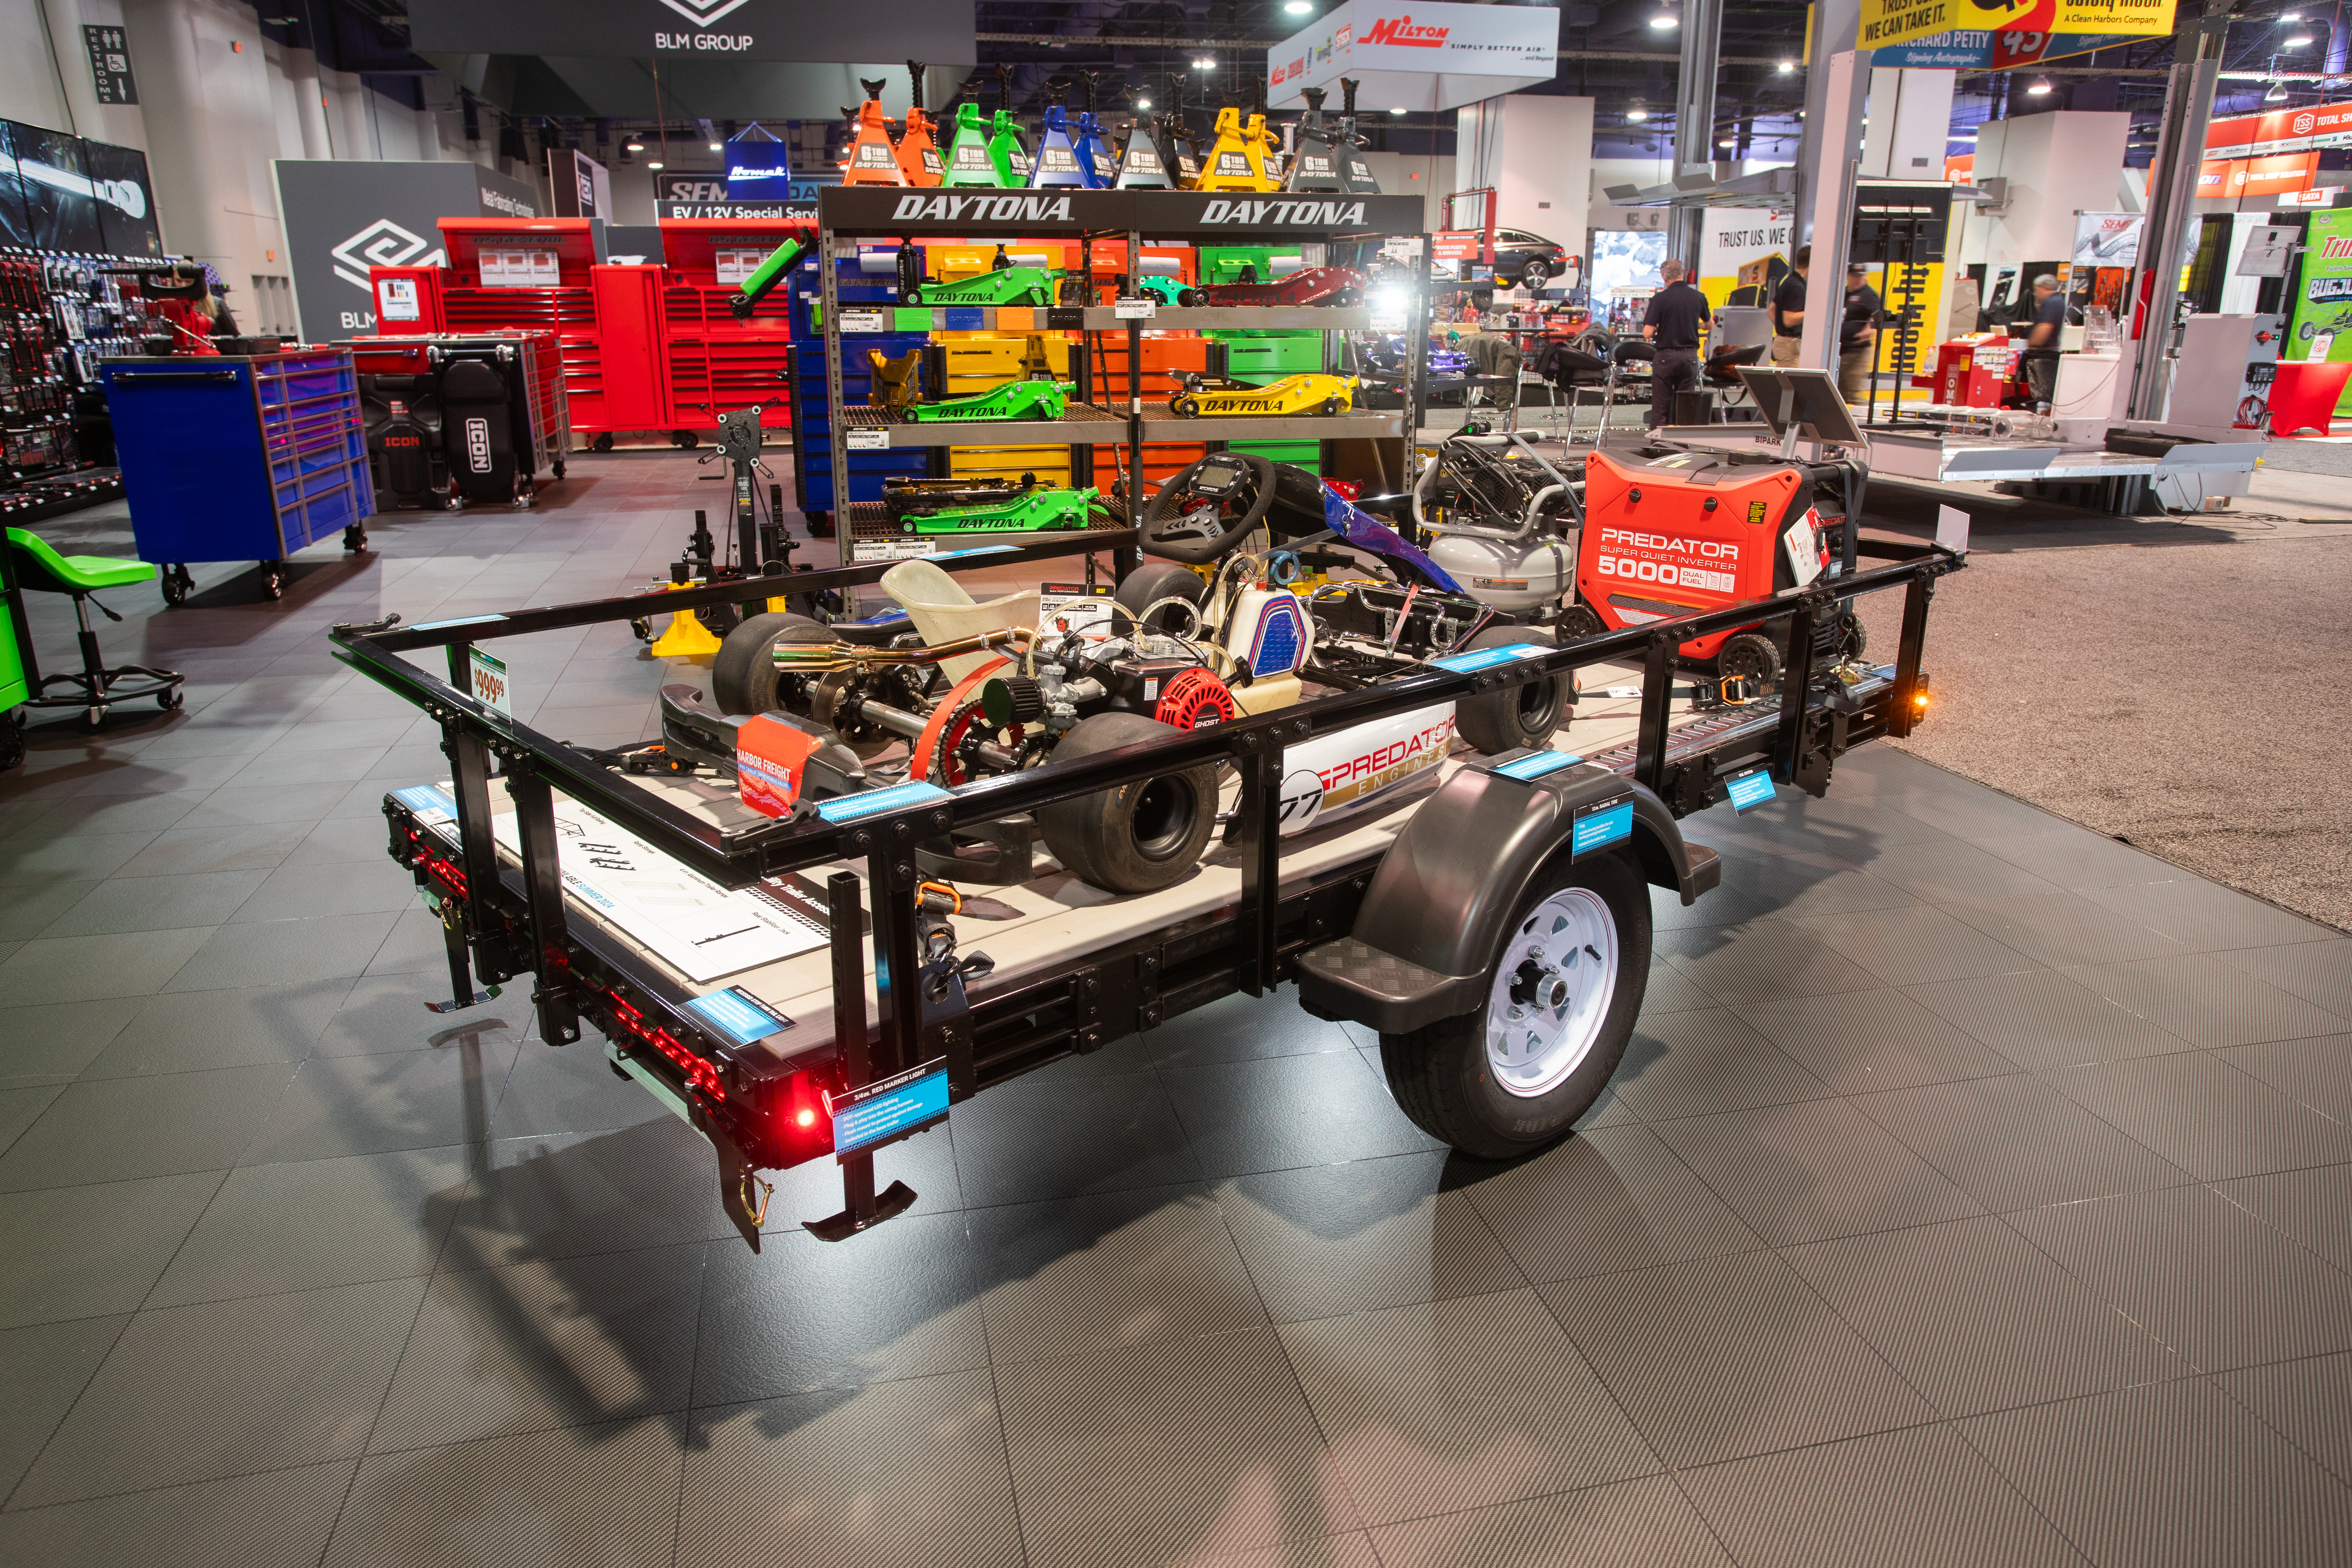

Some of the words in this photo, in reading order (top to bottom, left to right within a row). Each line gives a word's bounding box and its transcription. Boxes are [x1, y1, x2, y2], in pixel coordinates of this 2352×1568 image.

[1865, 22, 1881, 41] WE
[1882, 15, 1904, 37] CAN
[1905, 10, 1931, 31] TAKE
[1932, 3, 1945, 22] IT.
[2072, 14, 2092, 23] Clean
[2093, 14, 2123, 24] Harbors
[2124, 15, 2158, 26] Company
[655, 33, 690, 49] BLM
[695, 34, 753, 51] GROUP
[1953, 31, 1989, 49] PETTY
[89, 28, 111, 102] RESTROOMS
[1905, 53, 1933, 63] Signing
[2296, 117, 2310, 127] TSS
[2317, 116, 2339, 126] TOTAL
[861, 146, 872, 161] 6
[872, 148, 887, 156] TON
[959, 148, 969, 163] 6
[969, 149, 984, 158] TON
[1046, 150, 1056, 164] 6
[1055, 151, 1071, 160] TON
[1131, 152, 1140, 166] 6
[1140, 154, 1155, 162] TON
[1221, 154, 1231, 168] 6
[1179, 156, 1187, 170] 6
[1185, 158, 1195, 167] TON
[1305, 156, 1314, 170] 6
[1351, 161, 1360, 175] 6
[1357, 163, 1367, 171] TON
[731, 166, 786, 176] Homak
[2299, 193, 2320, 201] SATA
[672, 207, 692, 219] EV
[705, 207, 732, 219] 12V
[735, 206, 782, 219] Special
[892, 195, 1071, 220] DAYTONA
[1199, 200, 1365, 225] DAYTONA
[1719, 231, 1748, 248] TRUST
[1750, 229, 1765, 246] US.
[1769, 227, 1786, 245] WE
[839, 278, 897, 286] GENERAL
[934, 292, 994, 301] DAYTONA
[1213, 291, 1297, 303] DAYTONA
[340, 312, 377, 329] BLM
[938, 406, 1007, 418] DAYTONA
[1203, 400, 1284, 412] DAYTONA
[385, 437, 420, 447] ICON
[470, 422, 488, 468] ICON
[1755, 436, 1781, 446] BIPARK
[957, 519, 1025, 528] DAYTONA
[1601, 527, 1739, 560] PREDATOR
[1600, 545, 1638, 557] SUPER
[1641, 551, 1675, 562] QUIET
[1678, 556, 1736, 571] INVERTER
[1598, 555, 1679, 585] 5000
[1683, 571, 1704, 579] DUAL
[1361, 654, 1375, 664] VLR
[1195, 719, 1219, 728] GHOST
[1332, 714, 1455, 788] PREDATOR
[737, 748, 762, 770] HARBOR
[763, 759, 791, 781] FREIGHT
[1358, 745, 1445, 797] ENGINES
[746, 766, 756, 775] TOOLS
[758, 771, 777, 784] UNBEATABLE
[777, 779, 788, 788] VALUE
[812, 790, 862, 805] ELF-TIGHTENING
[861, 785, 890, 794] TAILGATE
[888, 780, 916, 789] STRAPS
[688, 873, 705, 885] Aluminum
[704, 883, 716, 891] Trailer
[714, 889, 729, 899] Ramps
[780, 884, 808, 899] Trailer
[576, 883, 603, 900] SUMMER
[597, 898, 616, 908] 2024
[761, 917, 781, 929] Stabilizer
[734, 988, 753, 1002] RECESSED
[752, 999, 763, 1009] STOP
[759, 1004, 771, 1014] TURN
[775, 1013, 789, 1024] LIGHT
[872, 1085, 883, 1094] RED
[884, 1076, 909, 1090] MARKER
[909, 1068, 926, 1080] LIGHT
[843, 1107, 873, 1122] DOT-approved
[883, 1097, 899, 1108] lighting
[858, 1116, 867, 1124] play
[884, 1105, 897, 1114] wiring
[897, 1098, 914, 1108] harness
[844, 1129, 856, 1137] Flush
[857, 1123, 871, 1131] mount
[876, 1115, 891, 1126] protect
[891, 1110, 907, 1120] against
[907, 1102, 923, 1113] damage
[845, 1132, 864, 1143] Included
[876, 1124, 887, 1132] base
[887, 1119, 900, 1128] trailer
